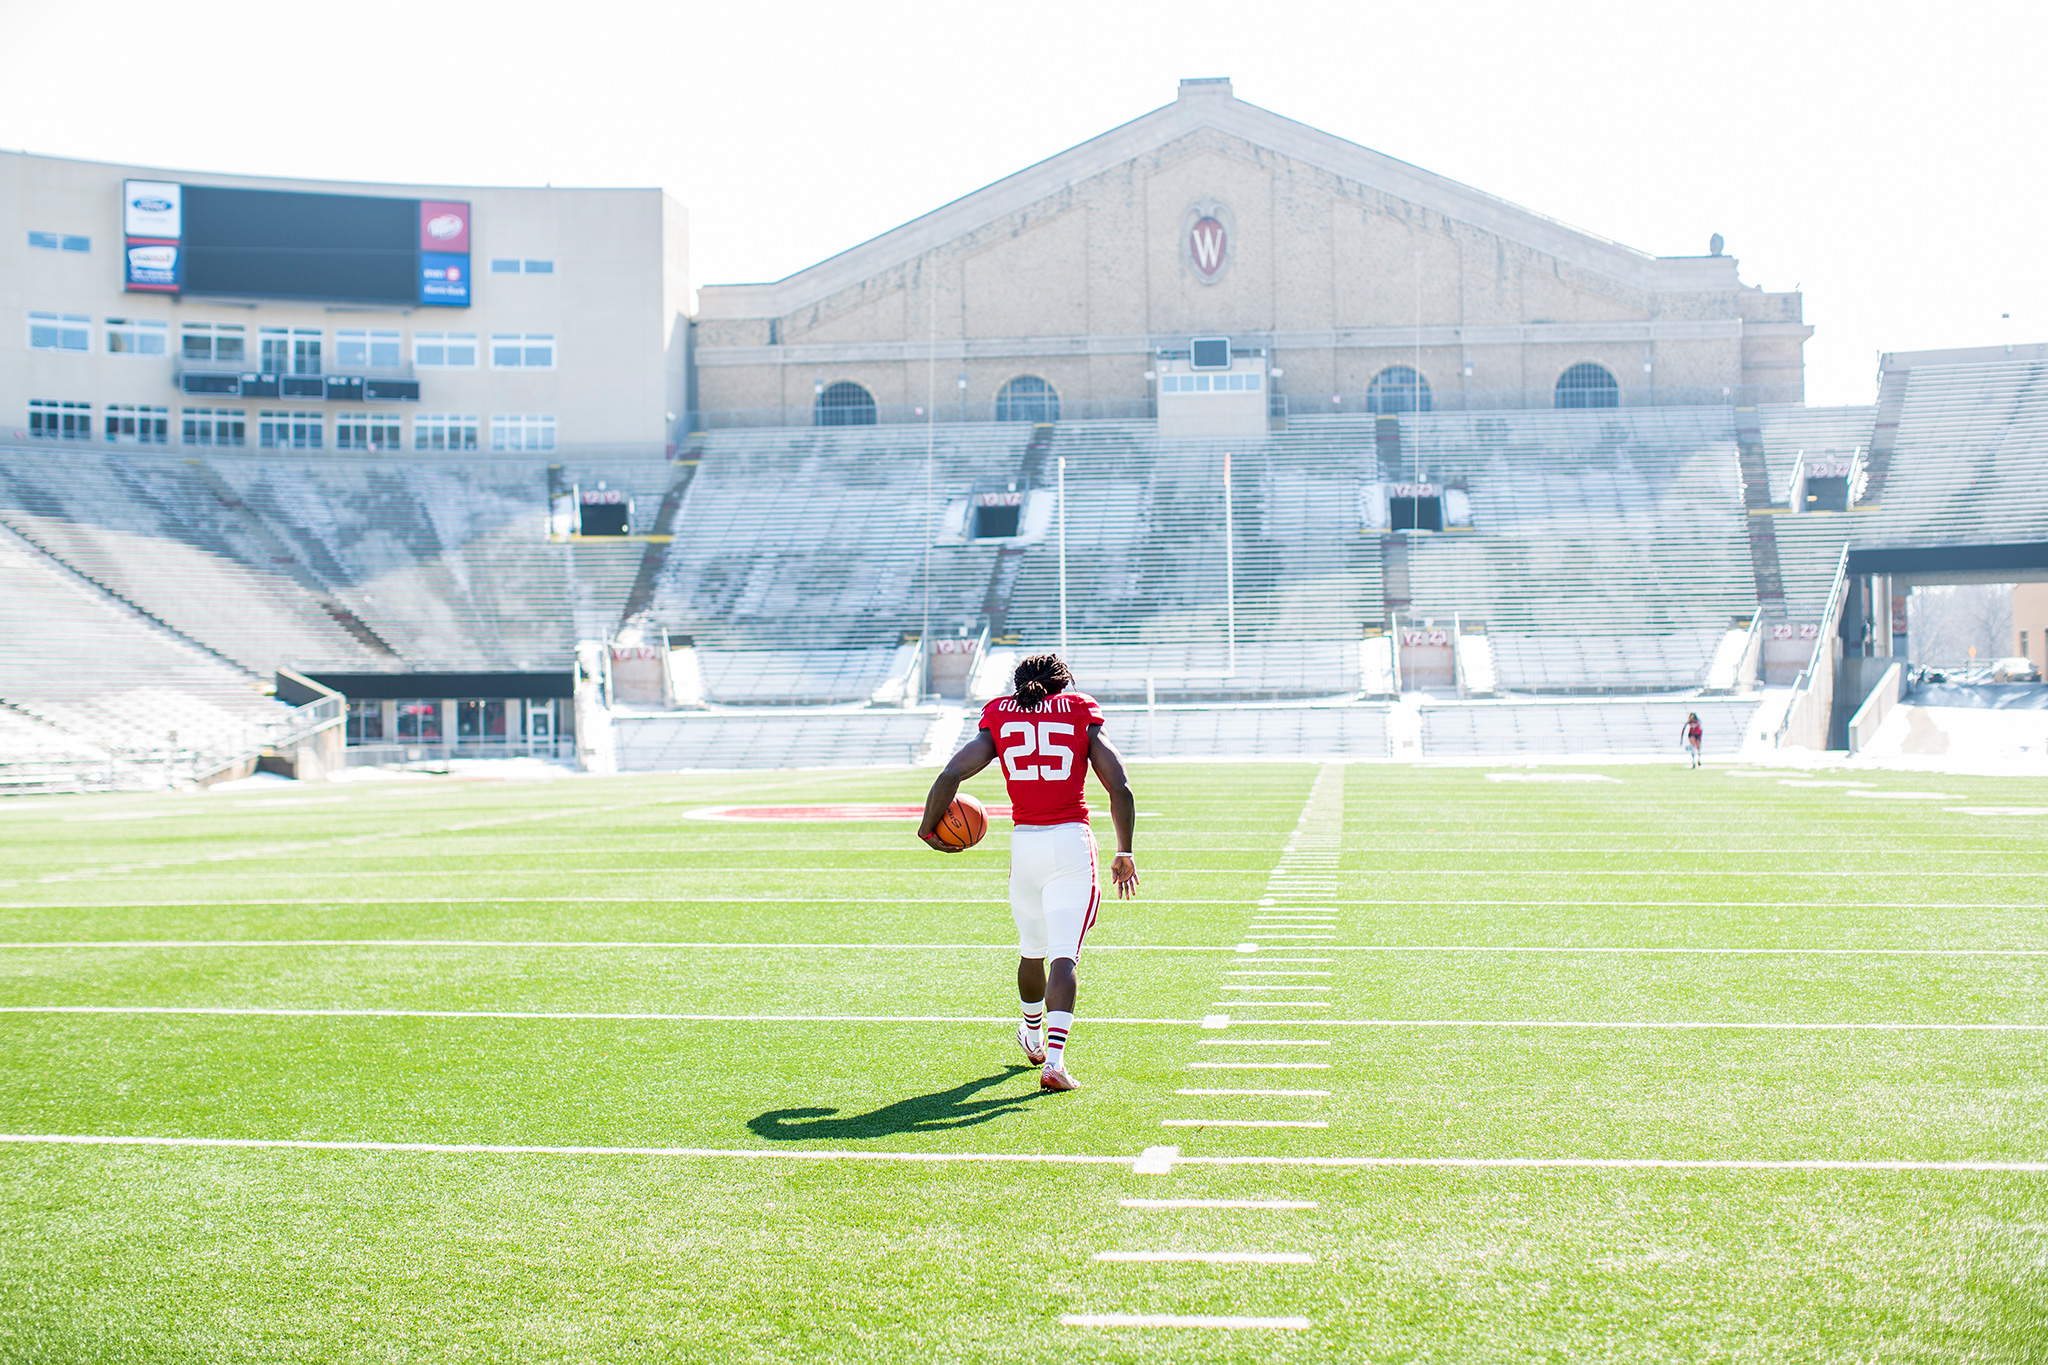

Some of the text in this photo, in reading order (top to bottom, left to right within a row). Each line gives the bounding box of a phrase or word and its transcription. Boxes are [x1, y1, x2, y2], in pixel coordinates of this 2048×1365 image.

[1192, 226, 1224, 270] W
[998, 698, 1072, 714] GOON III
[1000, 721, 1075, 781] 25
